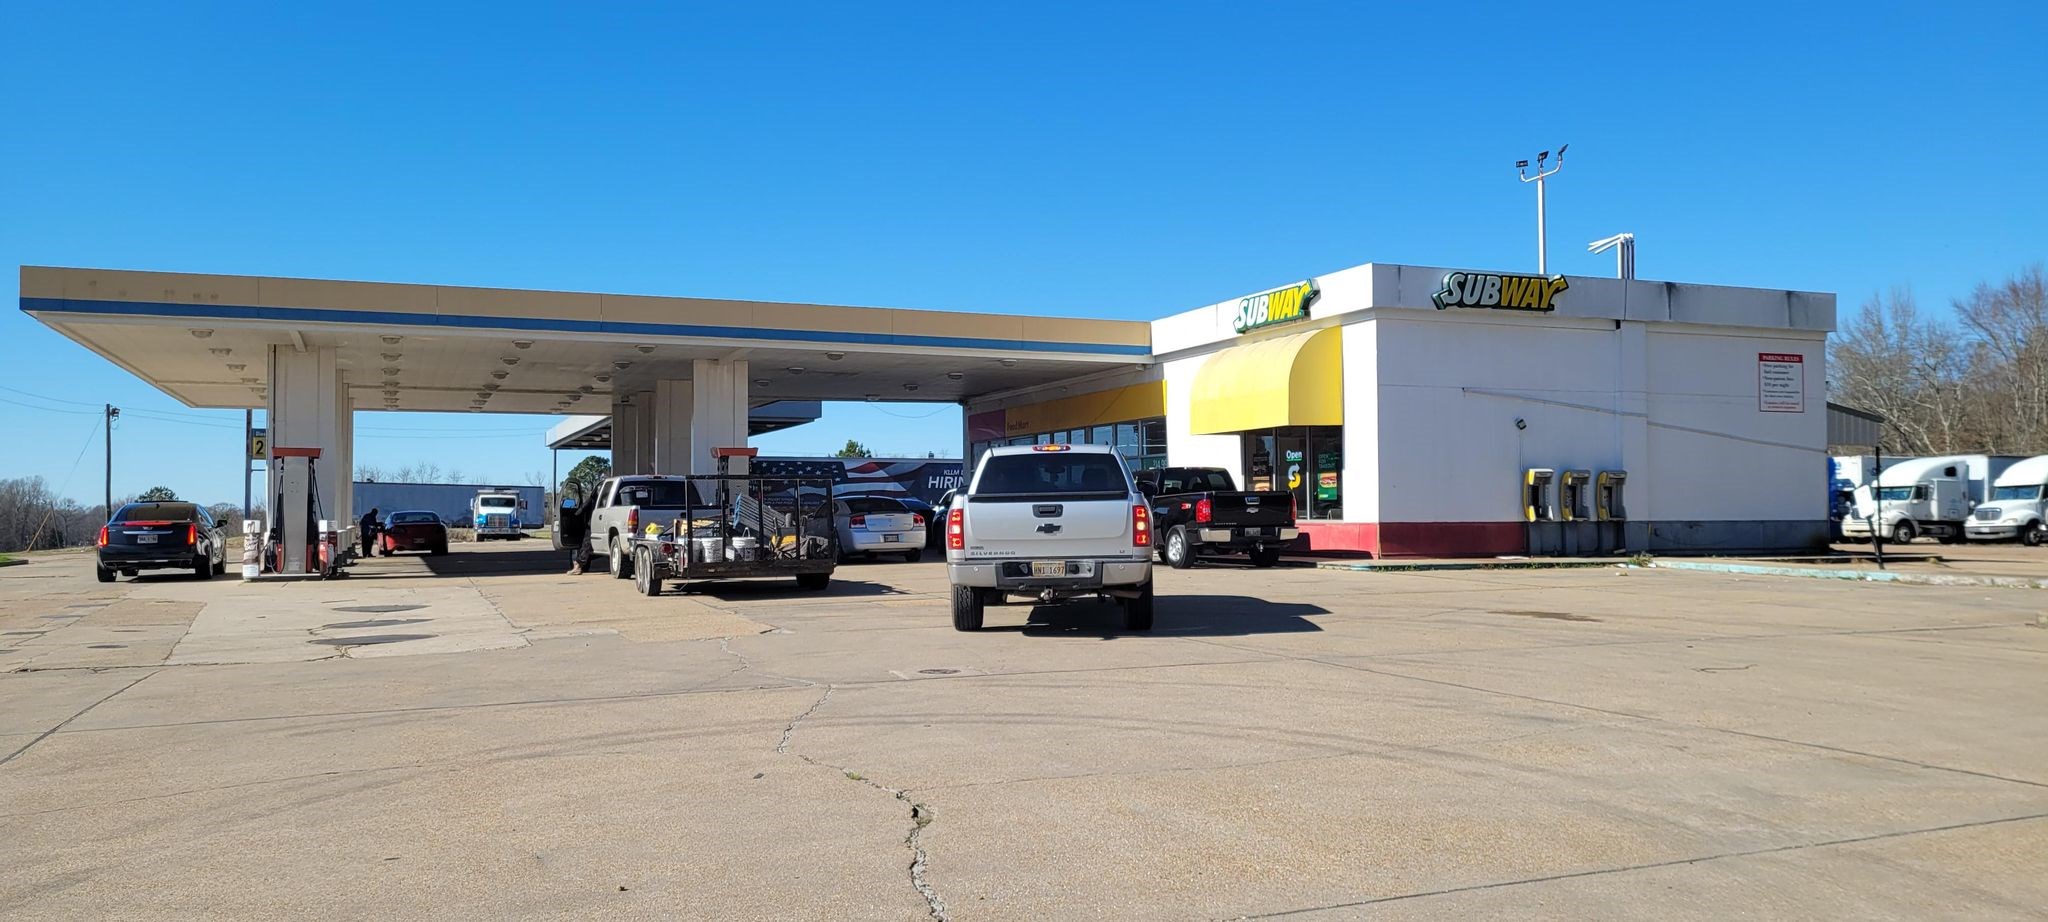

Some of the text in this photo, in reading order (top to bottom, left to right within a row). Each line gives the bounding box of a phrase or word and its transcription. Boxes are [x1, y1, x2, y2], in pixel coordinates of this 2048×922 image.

[1433, 272, 1568, 309] SUBWAY
[1234, 281, 1312, 331] SUBWAY
[256, 440, 264, 455] 2
[1286, 449, 1303, 460] Open
[928, 476, 964, 489] HIRIN
[1049, 566, 1065, 574] 1697
